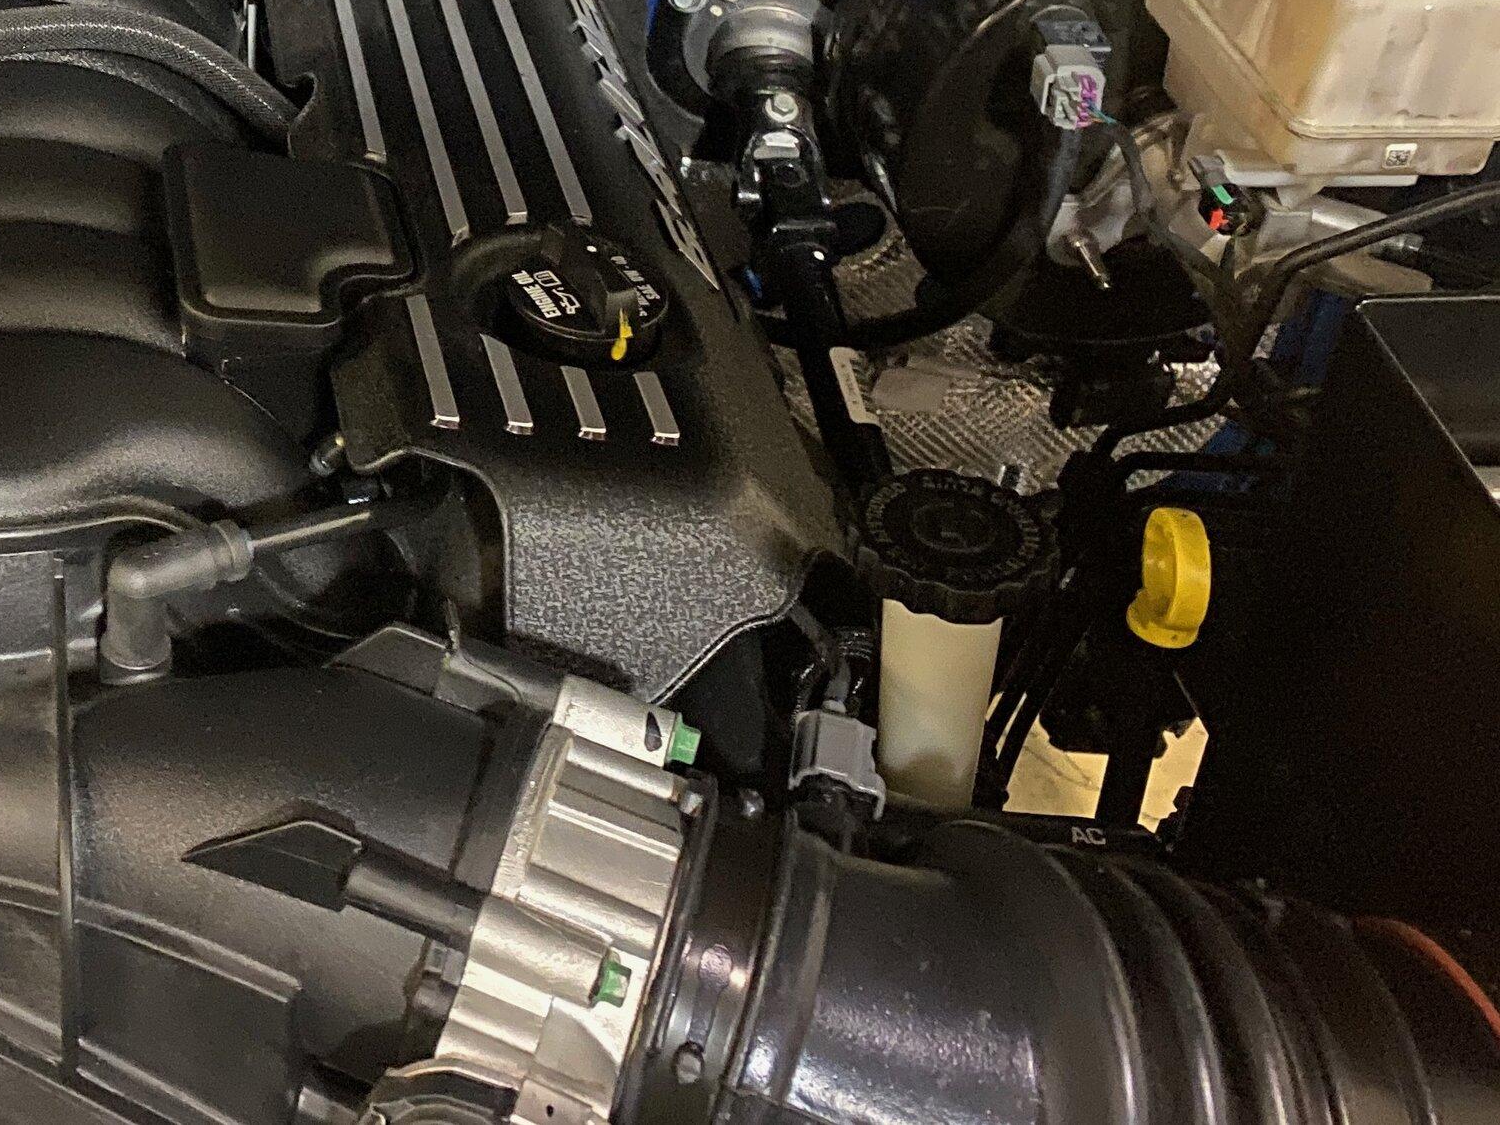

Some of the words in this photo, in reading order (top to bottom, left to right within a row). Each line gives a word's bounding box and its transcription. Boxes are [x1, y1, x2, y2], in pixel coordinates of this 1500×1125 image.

[511, 270, 534, 286] OIL
[522, 284, 562, 318] ENGINE
[1071, 826, 1106, 845] AC
